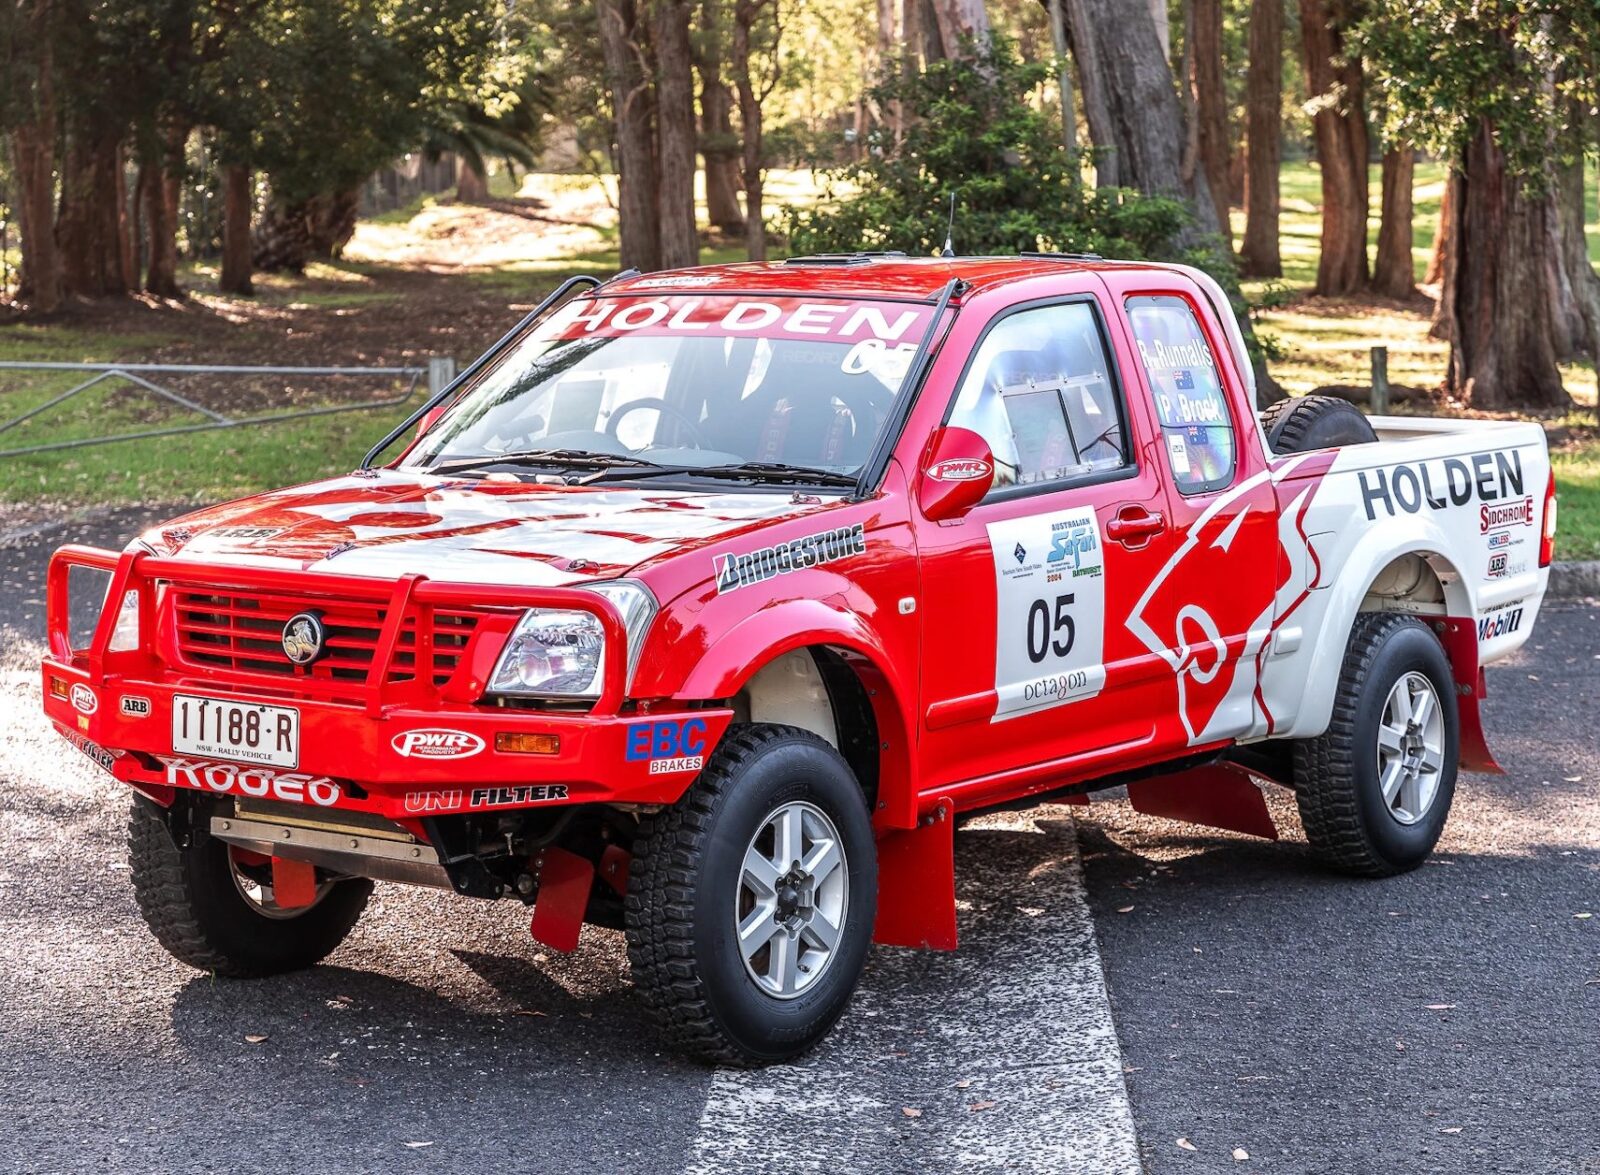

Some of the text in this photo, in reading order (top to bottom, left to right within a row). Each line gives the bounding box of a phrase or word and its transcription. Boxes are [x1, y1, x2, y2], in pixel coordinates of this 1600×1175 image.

[551, 301, 921, 341] HOLDEN
[935, 462, 985, 480] PWR
[1357, 449, 1525, 521] HOLDEN
[1051, 518, 1090, 531] AUSTRALIAN
[1480, 498, 1533, 532] SIDCHROME
[712, 523, 865, 595] BRIDGESTONE
[1047, 573, 1063, 583] 2004
[1027, 592, 1076, 664] 05
[1024, 669, 1087, 701] octagon
[124, 699, 147, 713] ARB
[196, 744, 212, 753] NSW
[218, 747, 240, 756] RALLY
[241, 750, 273, 761] VEHICLE
[401, 732, 478, 757] PWR
[626, 718, 707, 762] EBC
[651, 757, 702, 773] BRAKES
[160, 756, 341, 806] RODEO
[404, 784, 569, 812] UNI FILTER
